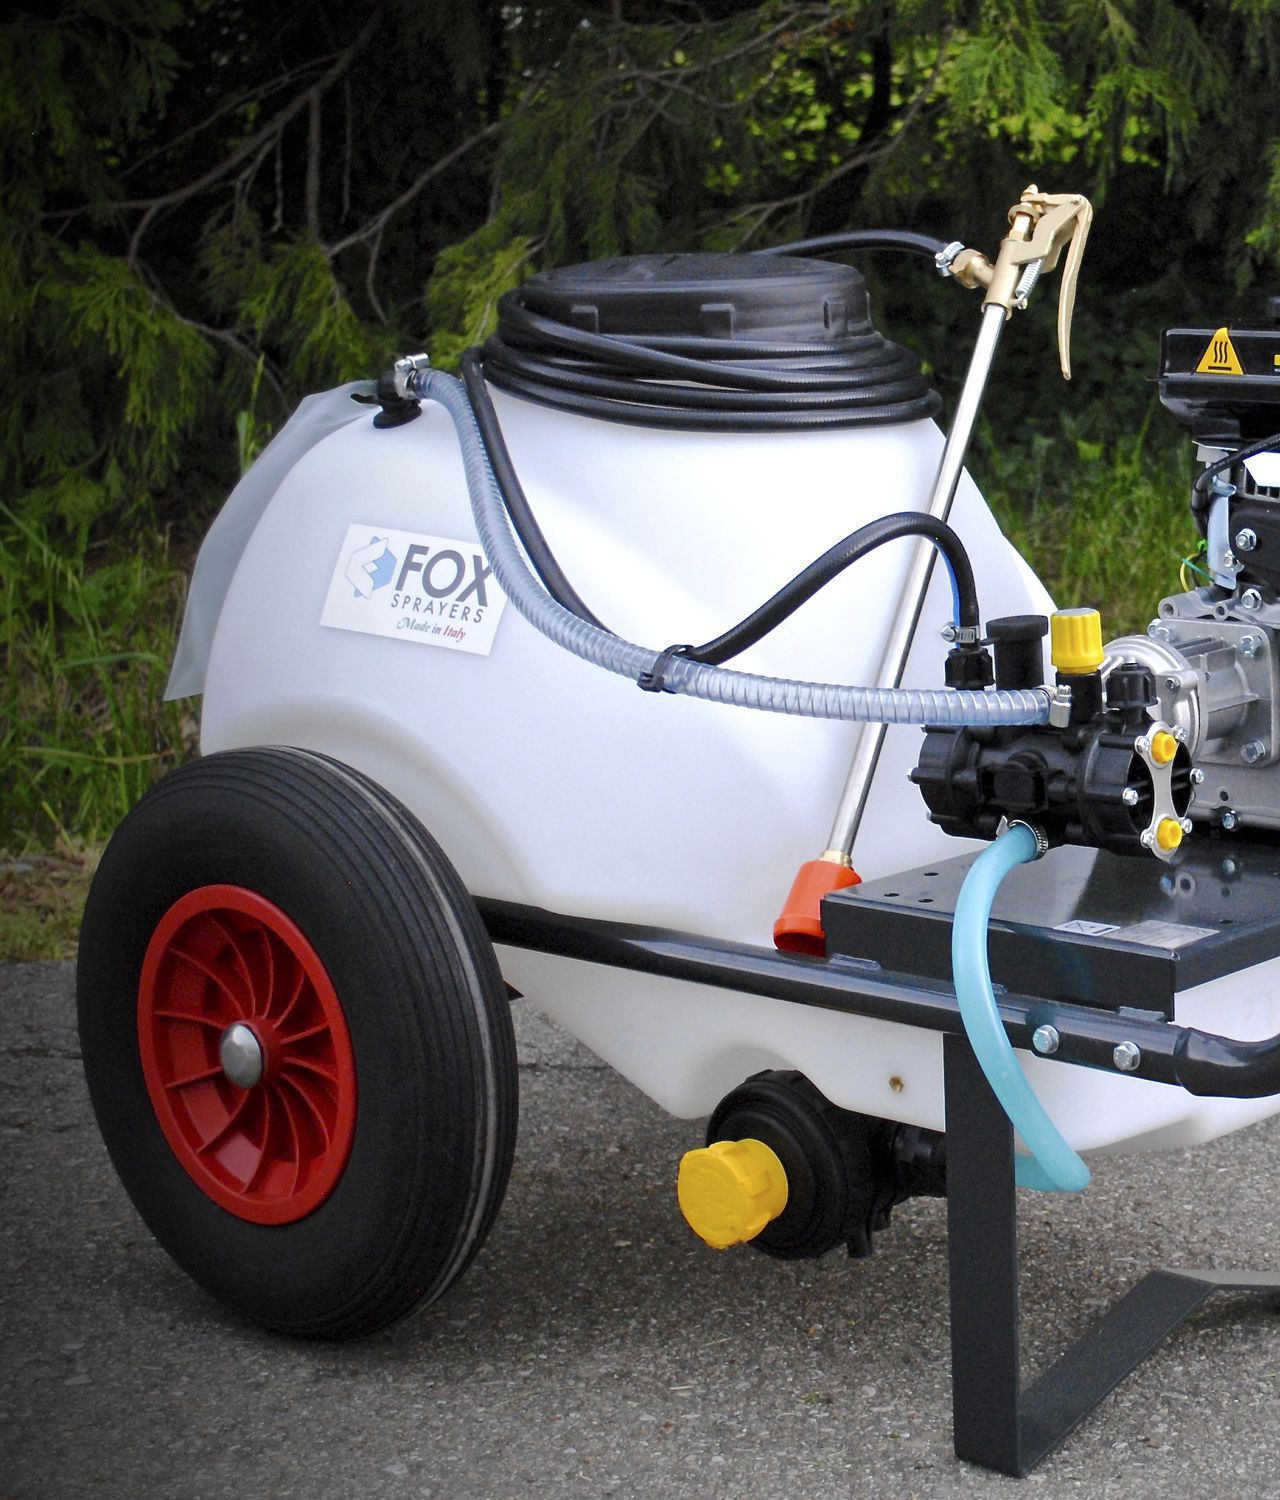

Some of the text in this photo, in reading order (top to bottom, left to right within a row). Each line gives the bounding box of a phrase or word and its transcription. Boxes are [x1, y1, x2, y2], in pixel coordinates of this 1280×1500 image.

[395, 543, 493, 608] FOX
[391, 593, 484, 623] SPRAYERS
[396, 617, 467, 643] Made in Italy
